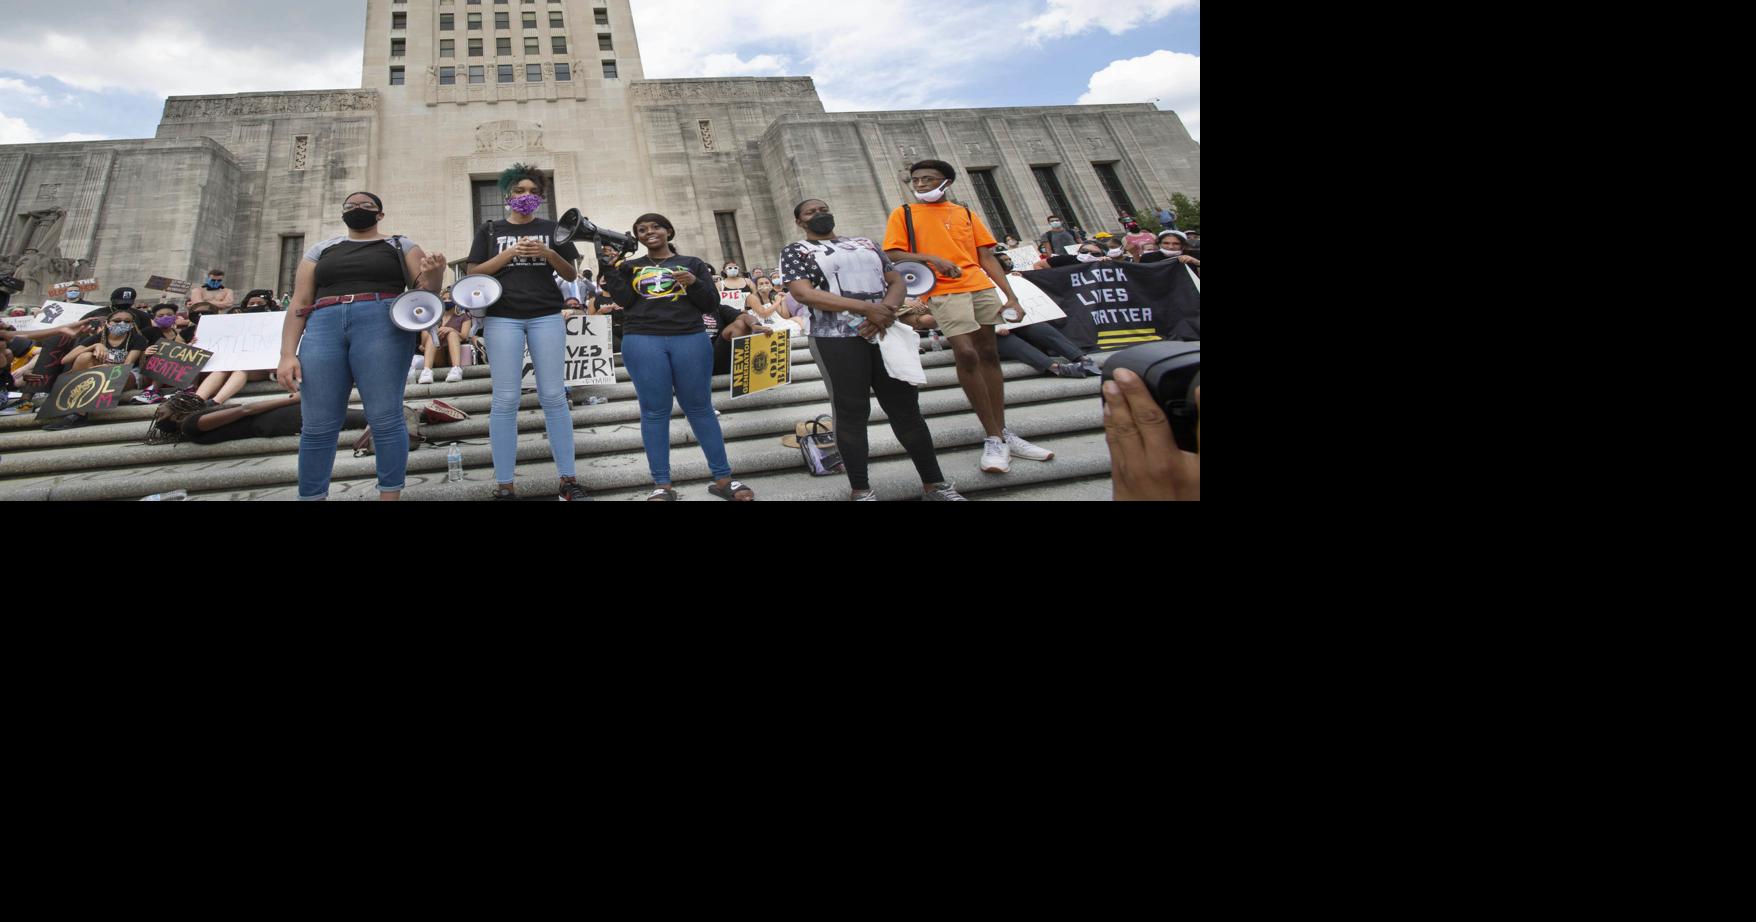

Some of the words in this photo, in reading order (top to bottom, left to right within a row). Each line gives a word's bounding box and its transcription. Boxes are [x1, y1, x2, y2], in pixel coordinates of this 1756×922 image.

[53, 280, 75, 289] STOP
[79, 278, 96, 286] THE
[1070, 268, 1128, 287] BLACK
[721, 291, 739, 300] DIE
[1091, 307, 1152, 325] MATTER
[157, 341, 170, 355] I
[770, 340, 778, 378] OLD
[777, 331, 786, 384] BATTLE
[733, 348, 744, 387] NEW
